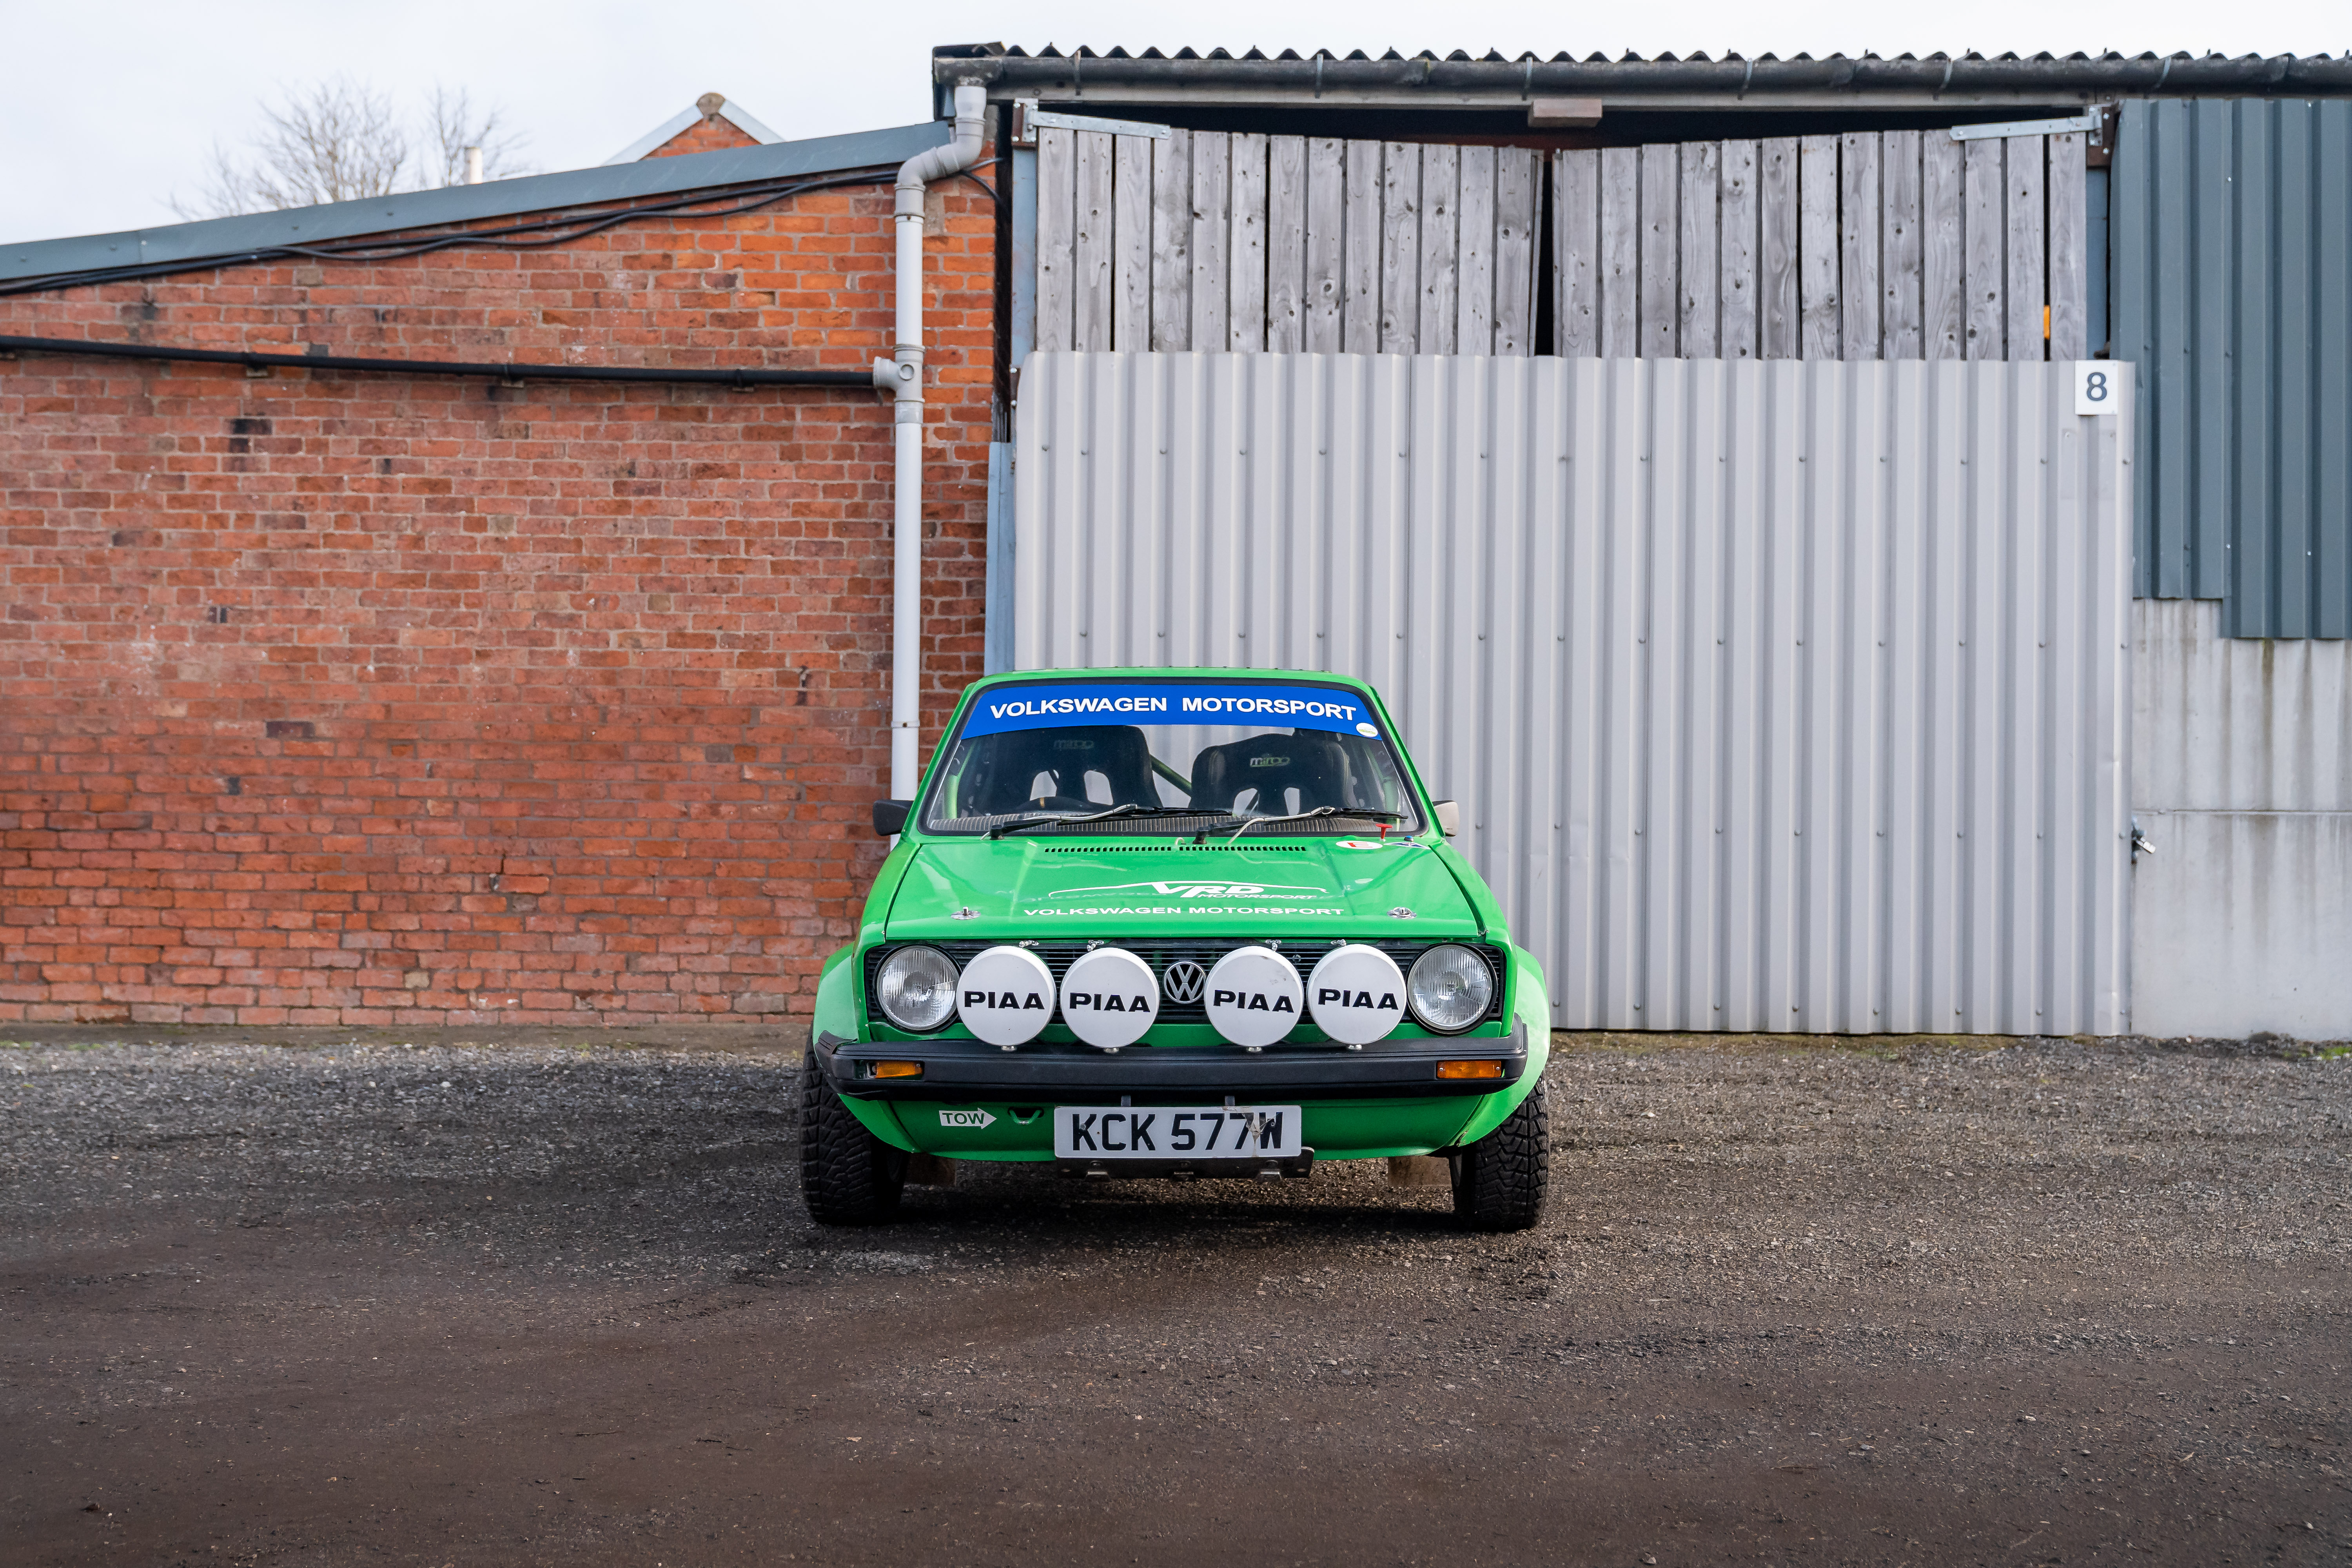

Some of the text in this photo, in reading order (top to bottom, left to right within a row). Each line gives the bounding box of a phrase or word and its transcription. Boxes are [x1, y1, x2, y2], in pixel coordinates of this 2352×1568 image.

[2086, 372, 2107, 401] 8
[990, 697, 1357, 720] VOLKSWAGEN MOTORSPORT
[1151, 881, 1265, 898] VRD
[1024, 907, 1345, 916] VOLKSWAGEN MOTORSPORT
[964, 991, 1045, 1010] PIAA
[1069, 992, 1151, 1013] PIAA
[1213, 989, 1294, 1013] PIAA
[1318, 988, 1399, 1010] PIAA
[942, 1112, 985, 1124] TOW
[1072, 1111, 1283, 1151] KCK 577W
